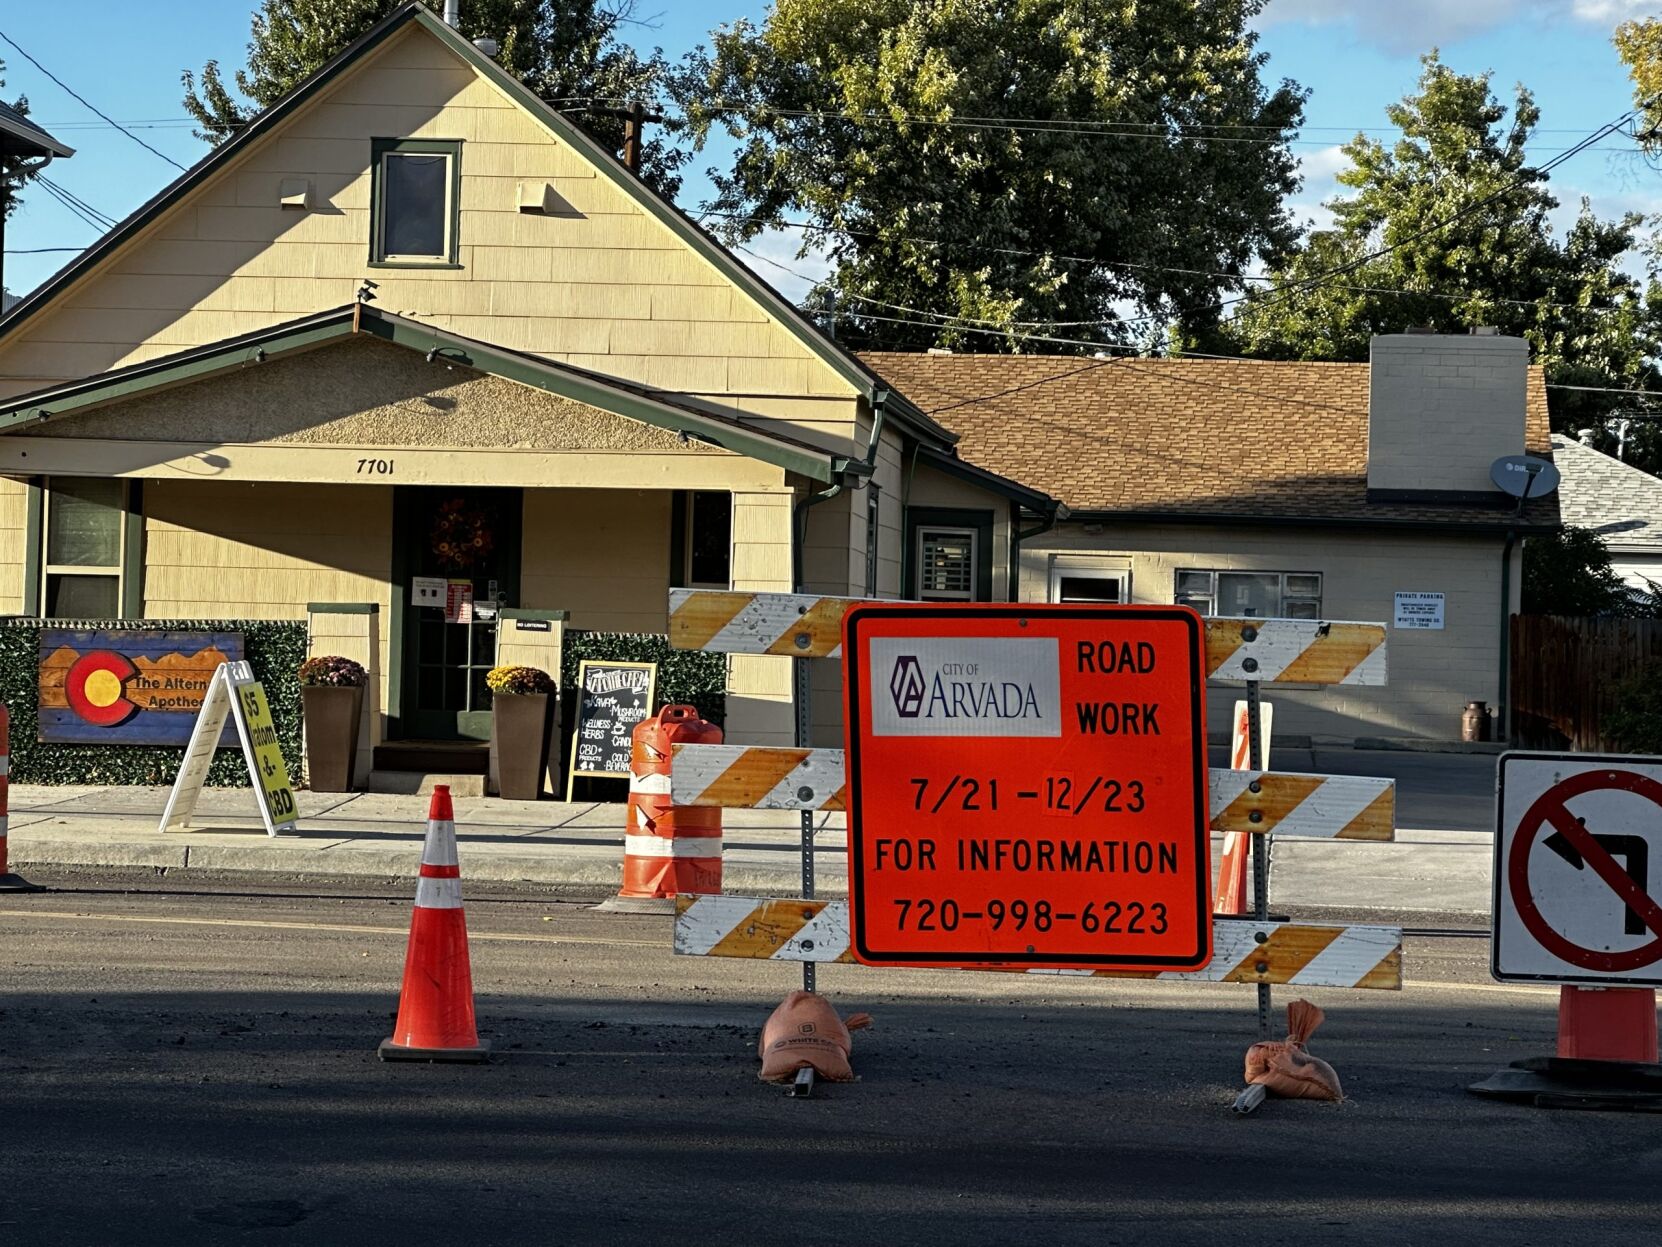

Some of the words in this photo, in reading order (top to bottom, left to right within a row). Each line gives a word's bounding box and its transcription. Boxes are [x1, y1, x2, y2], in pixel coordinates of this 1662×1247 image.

[357, 459, 394, 474] 7701
[942, 663, 964, 675] CITY
[966, 664, 979, 675] OF
[1077, 641, 1155, 674] ROAD
[136, 677, 160, 688] The
[165, 678, 209, 690] Altern
[925, 669, 1042, 718] ARVADA
[244, 691, 259, 717] $5
[611, 704, 646, 717] MUSHROOM
[1076, 702, 1160, 735] WORK
[249, 723, 276, 747] ratom
[581, 728, 604, 739] HERBS
[580, 744, 597, 755] CBD
[612, 753, 629, 762] COLD
[268, 788, 293, 816] CBD
[910, 775, 998, 813] 7/21
[876, 839, 936, 871] FOR
[958, 840, 1178, 874] INFORMATION
[894, 899, 1169, 934] 720-998-6223
